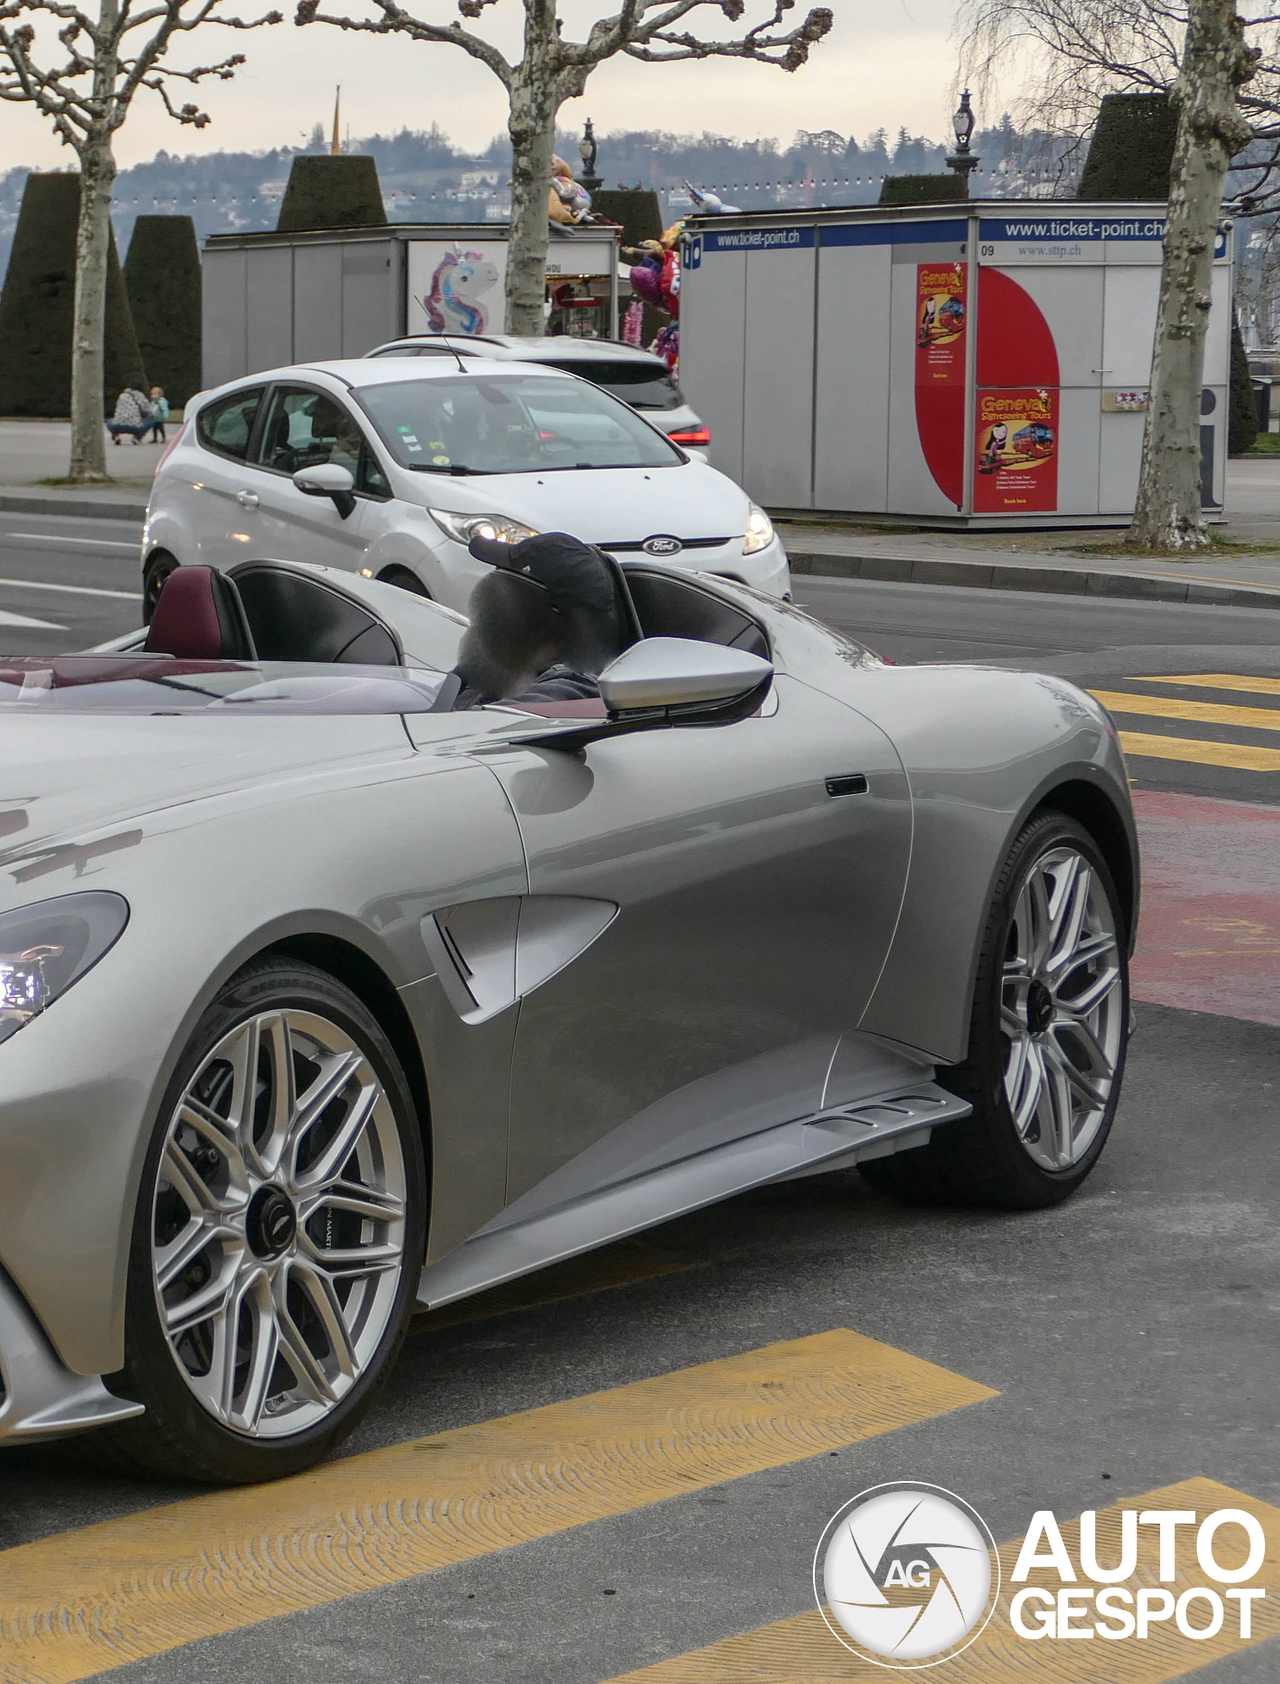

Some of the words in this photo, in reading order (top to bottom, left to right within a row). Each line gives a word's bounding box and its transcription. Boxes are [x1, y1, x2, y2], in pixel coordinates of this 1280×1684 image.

[1006, 221, 1163, 239] www.ticket-point.ch
[717, 229, 800, 248] www.ticket-point.ch
[981, 245, 994, 256] 09
[1018, 244, 1081, 258] www.sttp.ch
[1028, 411, 1052, 419] Tours
[652, 540, 674, 550] Ford
